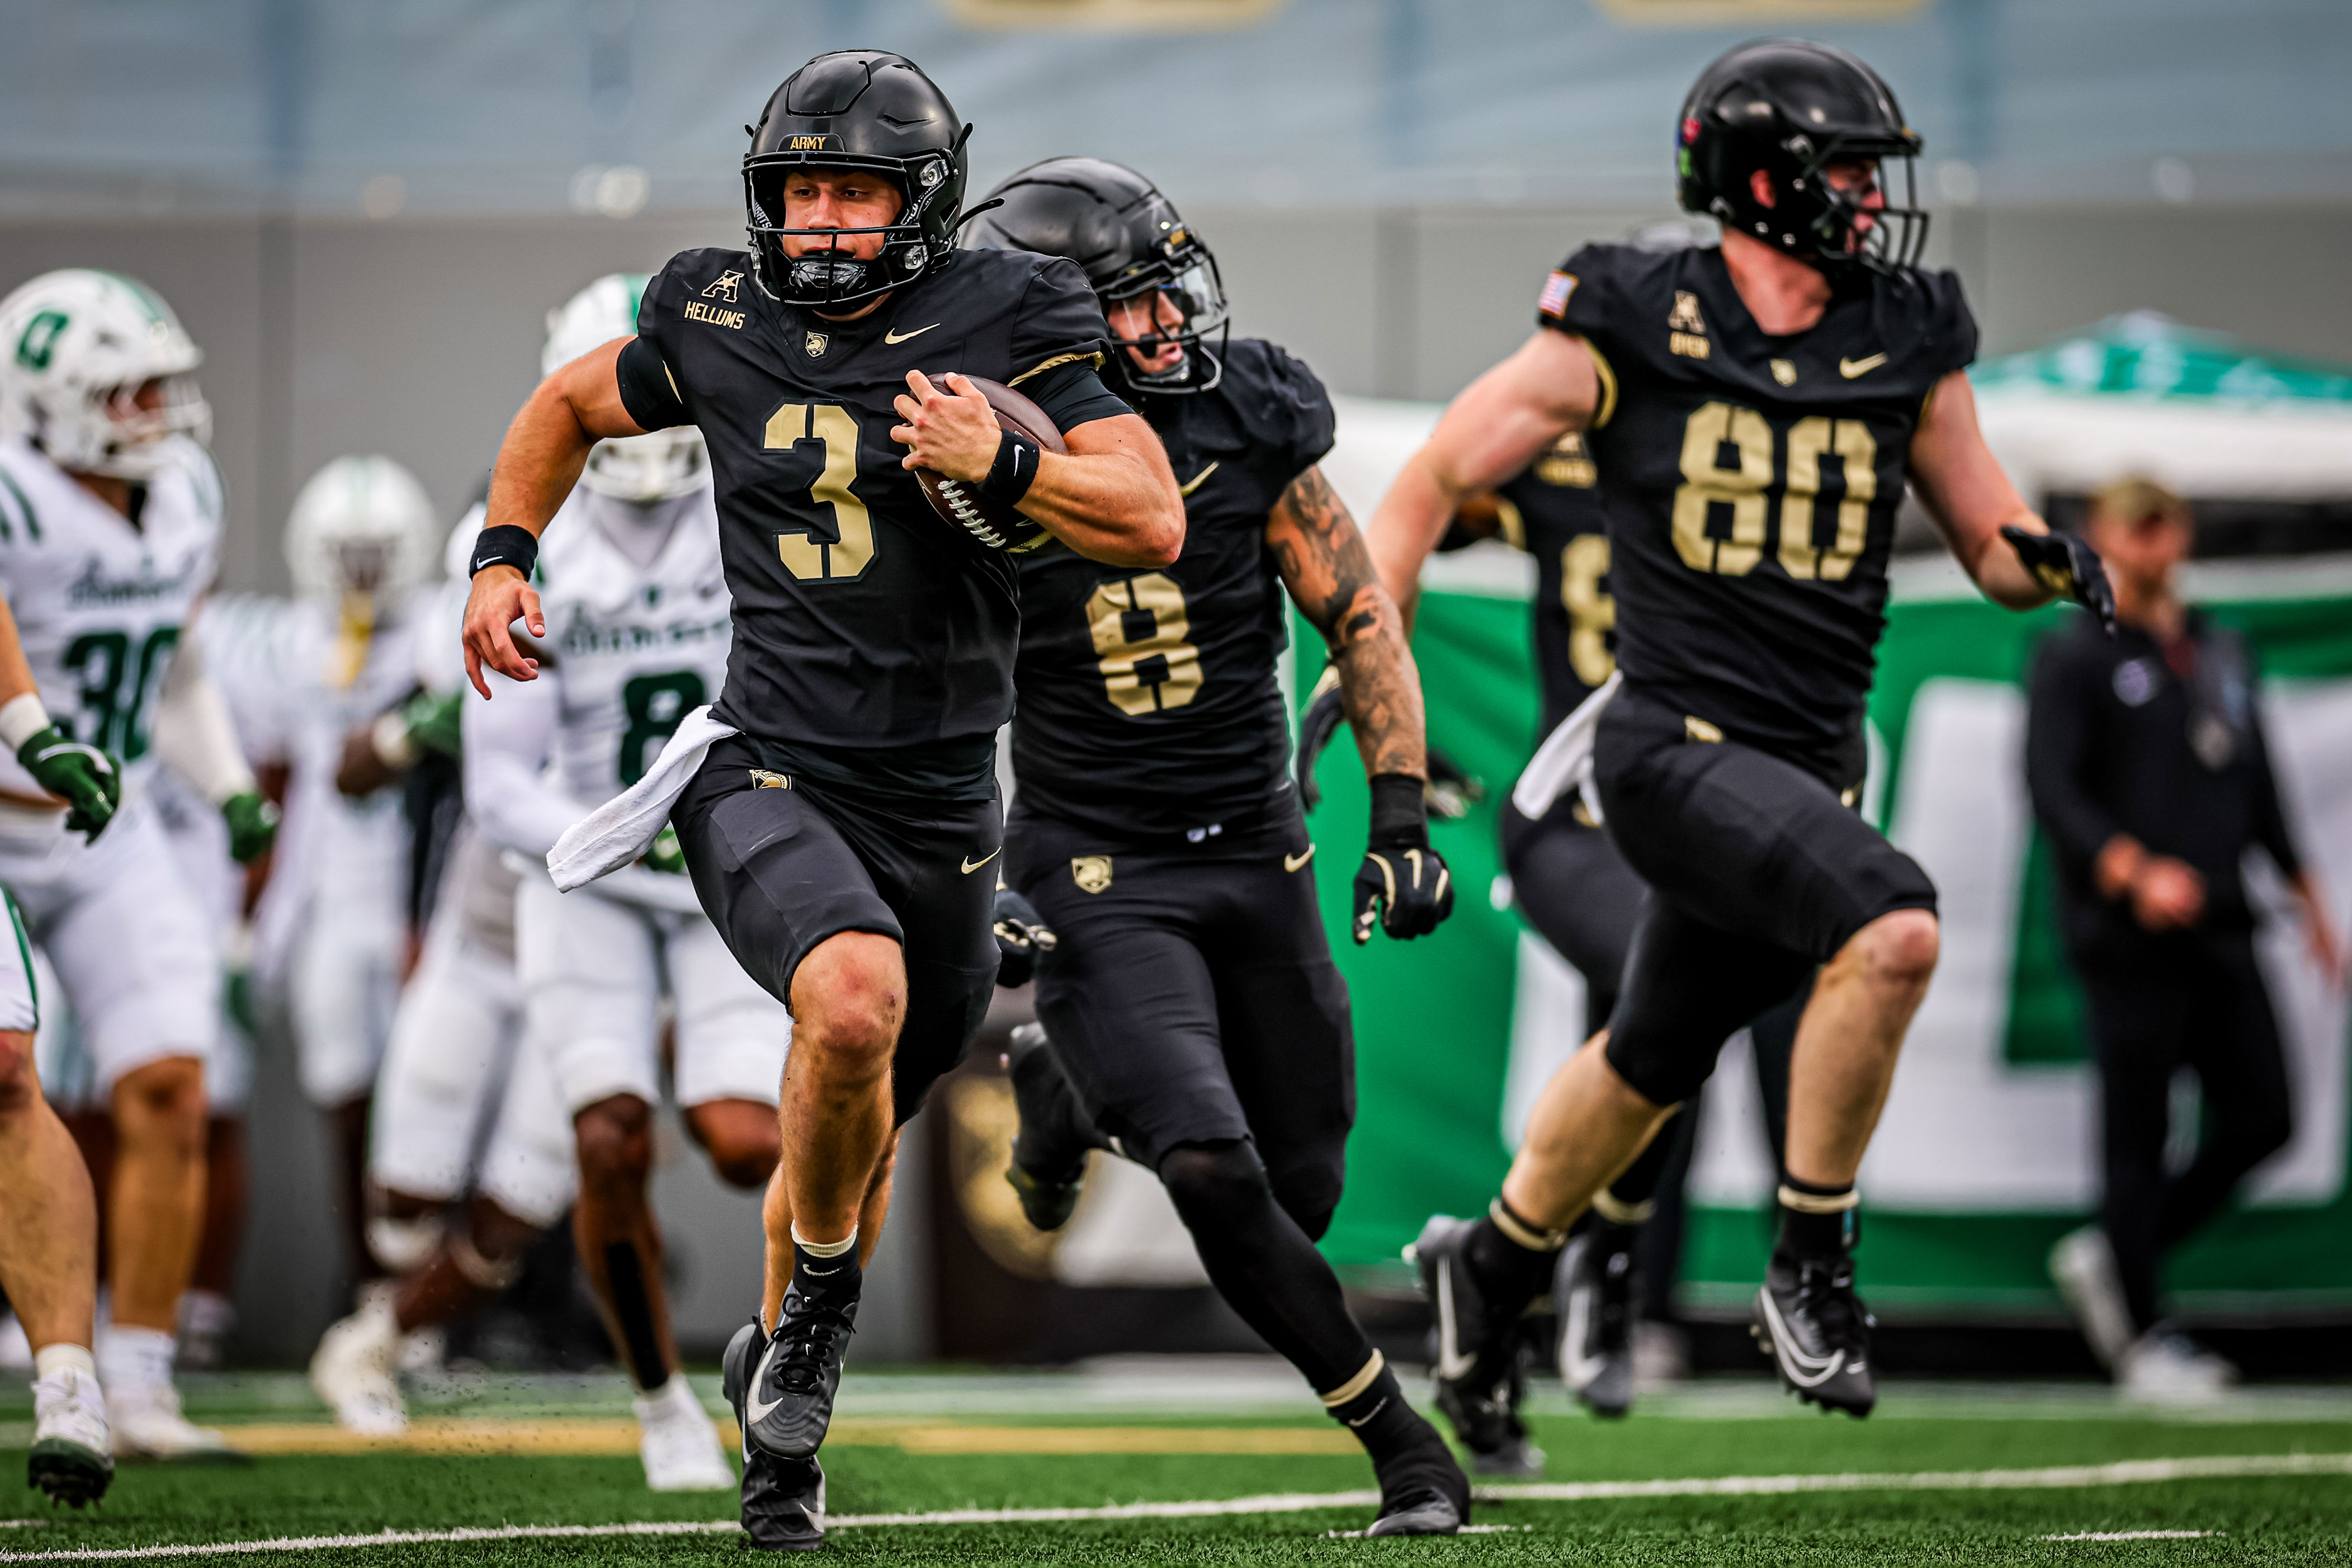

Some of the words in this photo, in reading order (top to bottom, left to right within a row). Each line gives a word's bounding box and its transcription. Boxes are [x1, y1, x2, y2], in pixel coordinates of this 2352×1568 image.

[790, 136, 827, 150] ARMY
[684, 301, 745, 329] HELLUMS
[764, 403, 875, 579] 3
[1672, 401, 1877, 580] 80
[1085, 572, 1204, 716] 8
